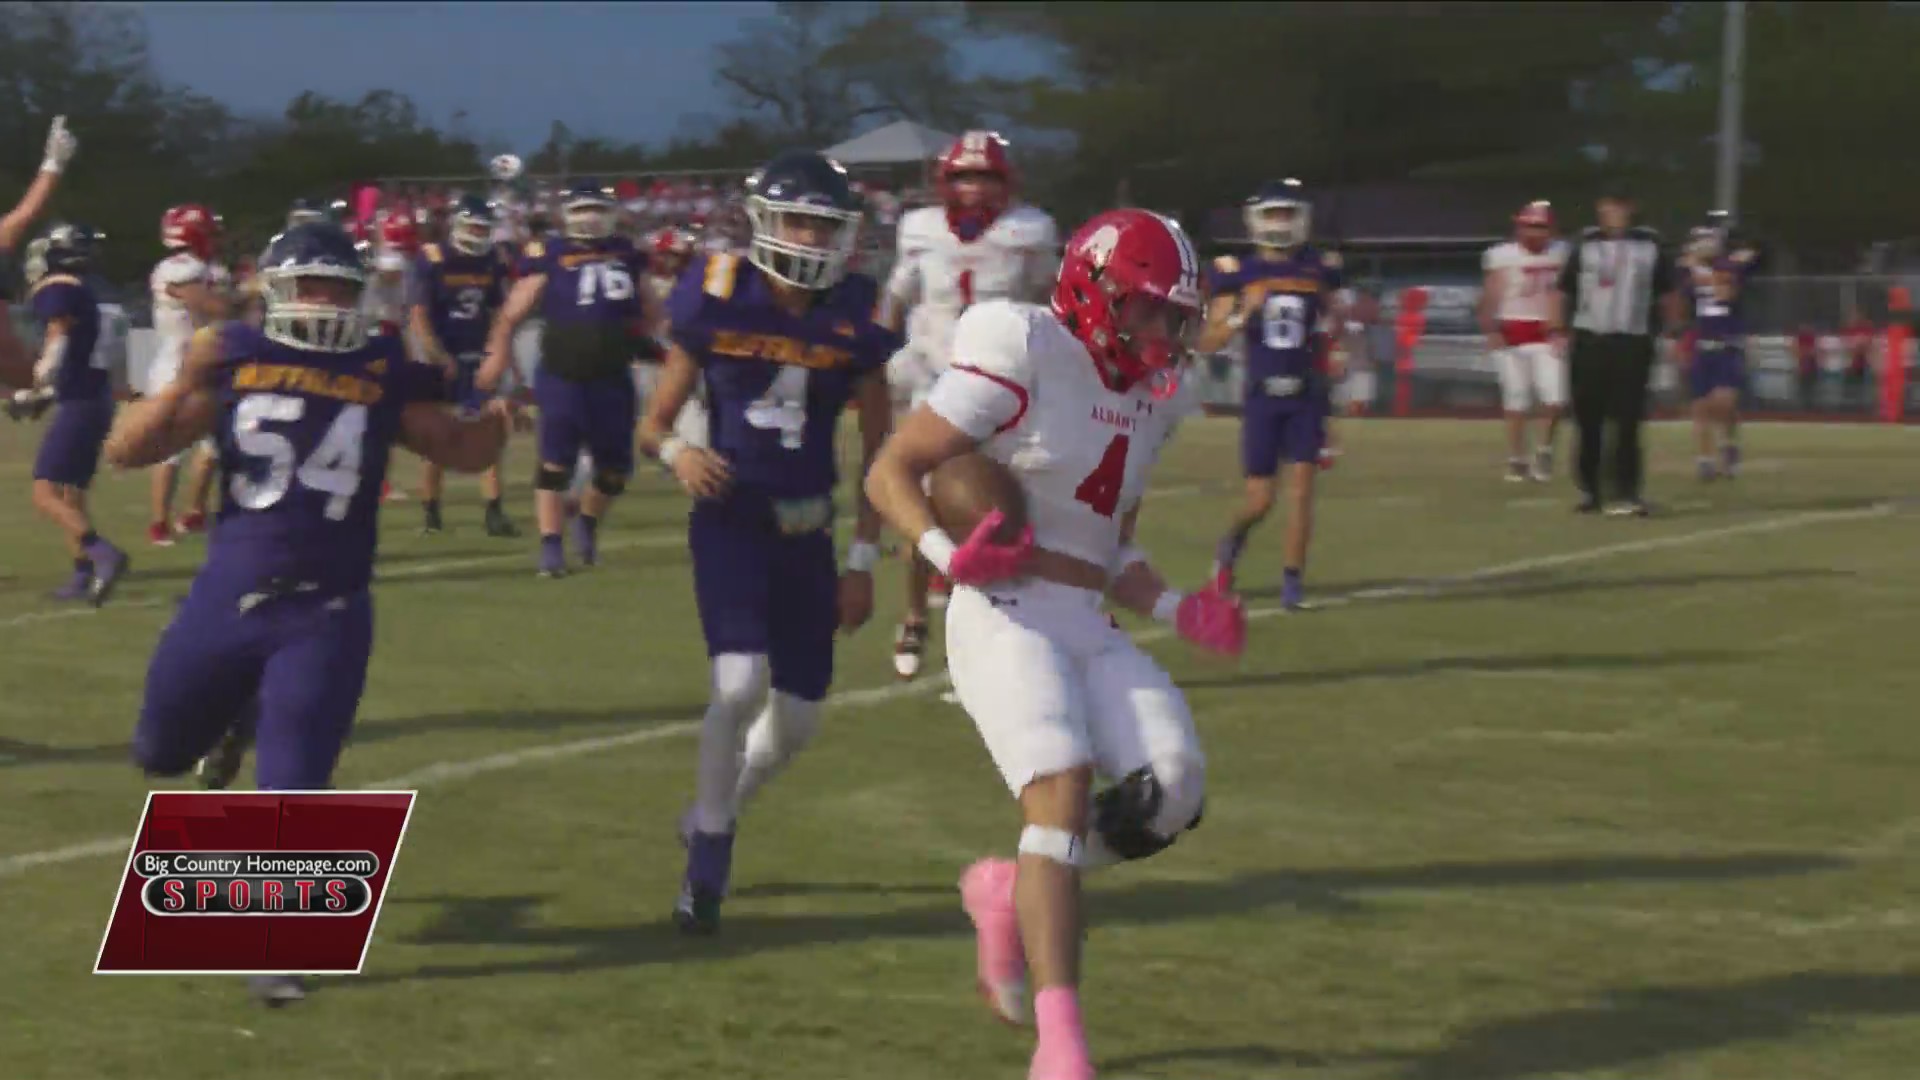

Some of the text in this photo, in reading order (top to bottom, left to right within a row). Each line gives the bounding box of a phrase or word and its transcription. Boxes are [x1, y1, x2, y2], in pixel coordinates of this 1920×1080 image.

[449, 288, 485, 320] 3
[744, 364, 808, 450] 4
[230, 392, 368, 522] 54
[1074, 432, 1130, 518] 4
